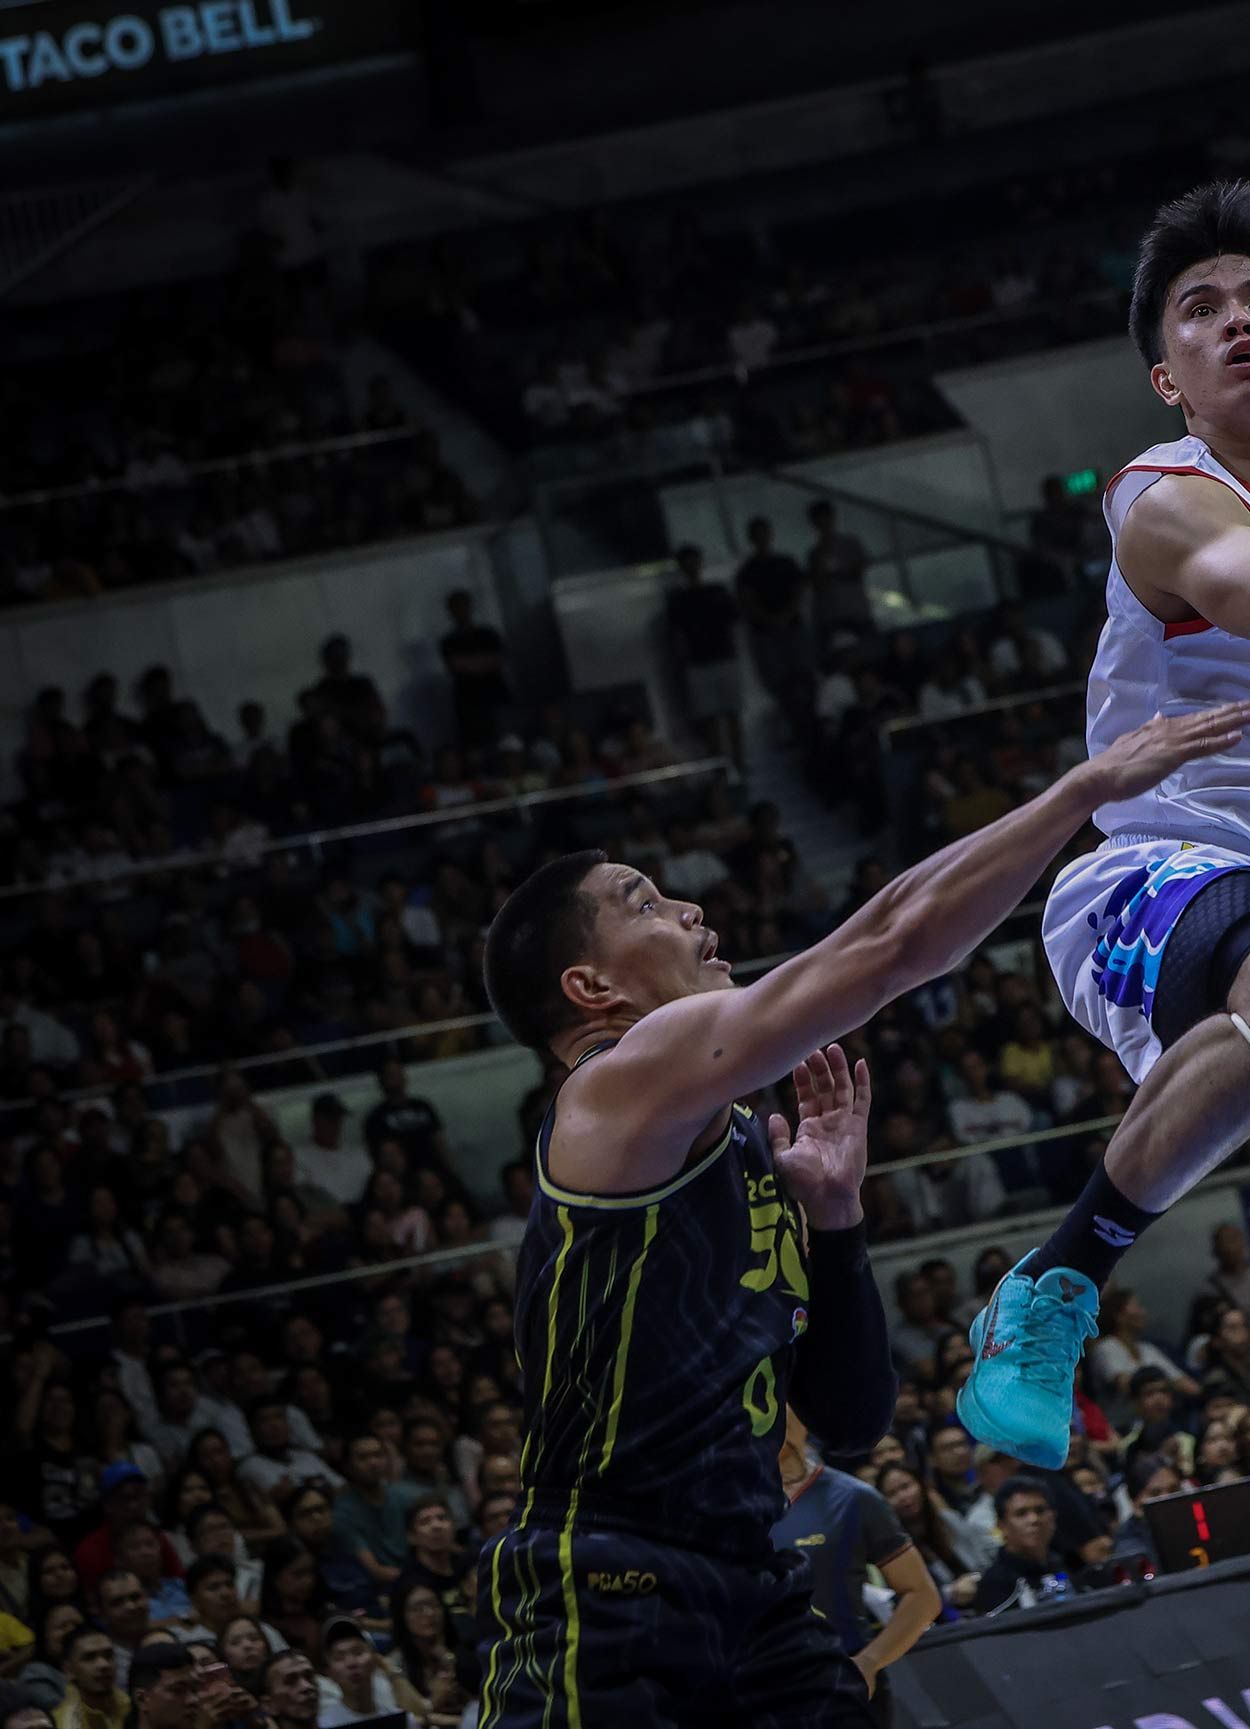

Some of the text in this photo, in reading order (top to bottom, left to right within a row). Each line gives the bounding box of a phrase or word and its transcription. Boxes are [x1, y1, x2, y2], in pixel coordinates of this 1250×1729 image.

[0, 0, 315, 93] TACO BELL
[742, 1355, 778, 1438] 0
